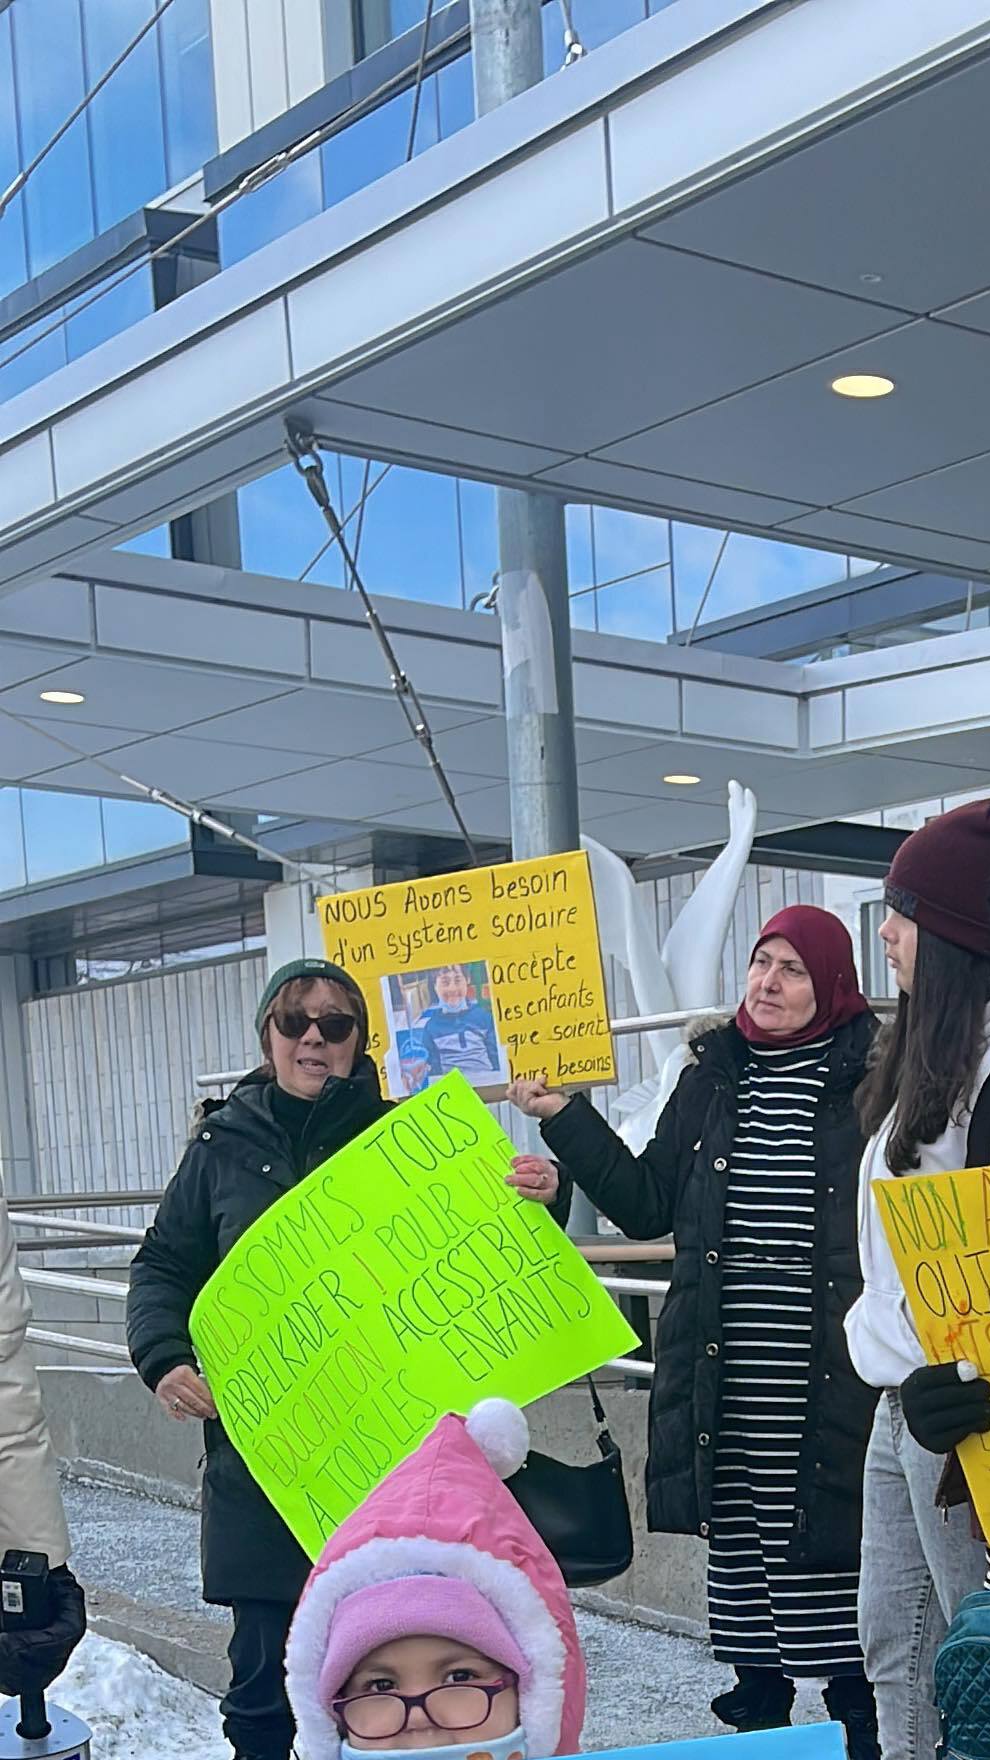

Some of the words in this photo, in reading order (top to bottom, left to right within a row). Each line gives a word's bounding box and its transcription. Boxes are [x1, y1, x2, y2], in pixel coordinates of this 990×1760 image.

[325, 891, 387, 925] NOUS
[491, 868, 568, 900] besoin
[333, 936, 375, 968] d'un
[491, 905, 578, 938] scolaire
[496, 997, 523, 1023] les
[526, 979, 595, 1017] enfants
[506, 1030, 539, 1056] que
[552, 1013, 612, 1041] soient
[557, 1052, 611, 1078] besoins
[233, 1175, 365, 1318] SOMMES
[363, 1092, 480, 1187] TOUS
[879, 1174, 970, 1255] NON
[221, 1268, 364, 1435] ABDELKADER
[374, 1182, 480, 1271] POUR
[381, 1199, 561, 1354] ACCESSIBLE
[315, 1414, 392, 1504] TOUS
[380, 1368, 438, 1447] LES
[438, 1261, 592, 1383] ENFANTS
